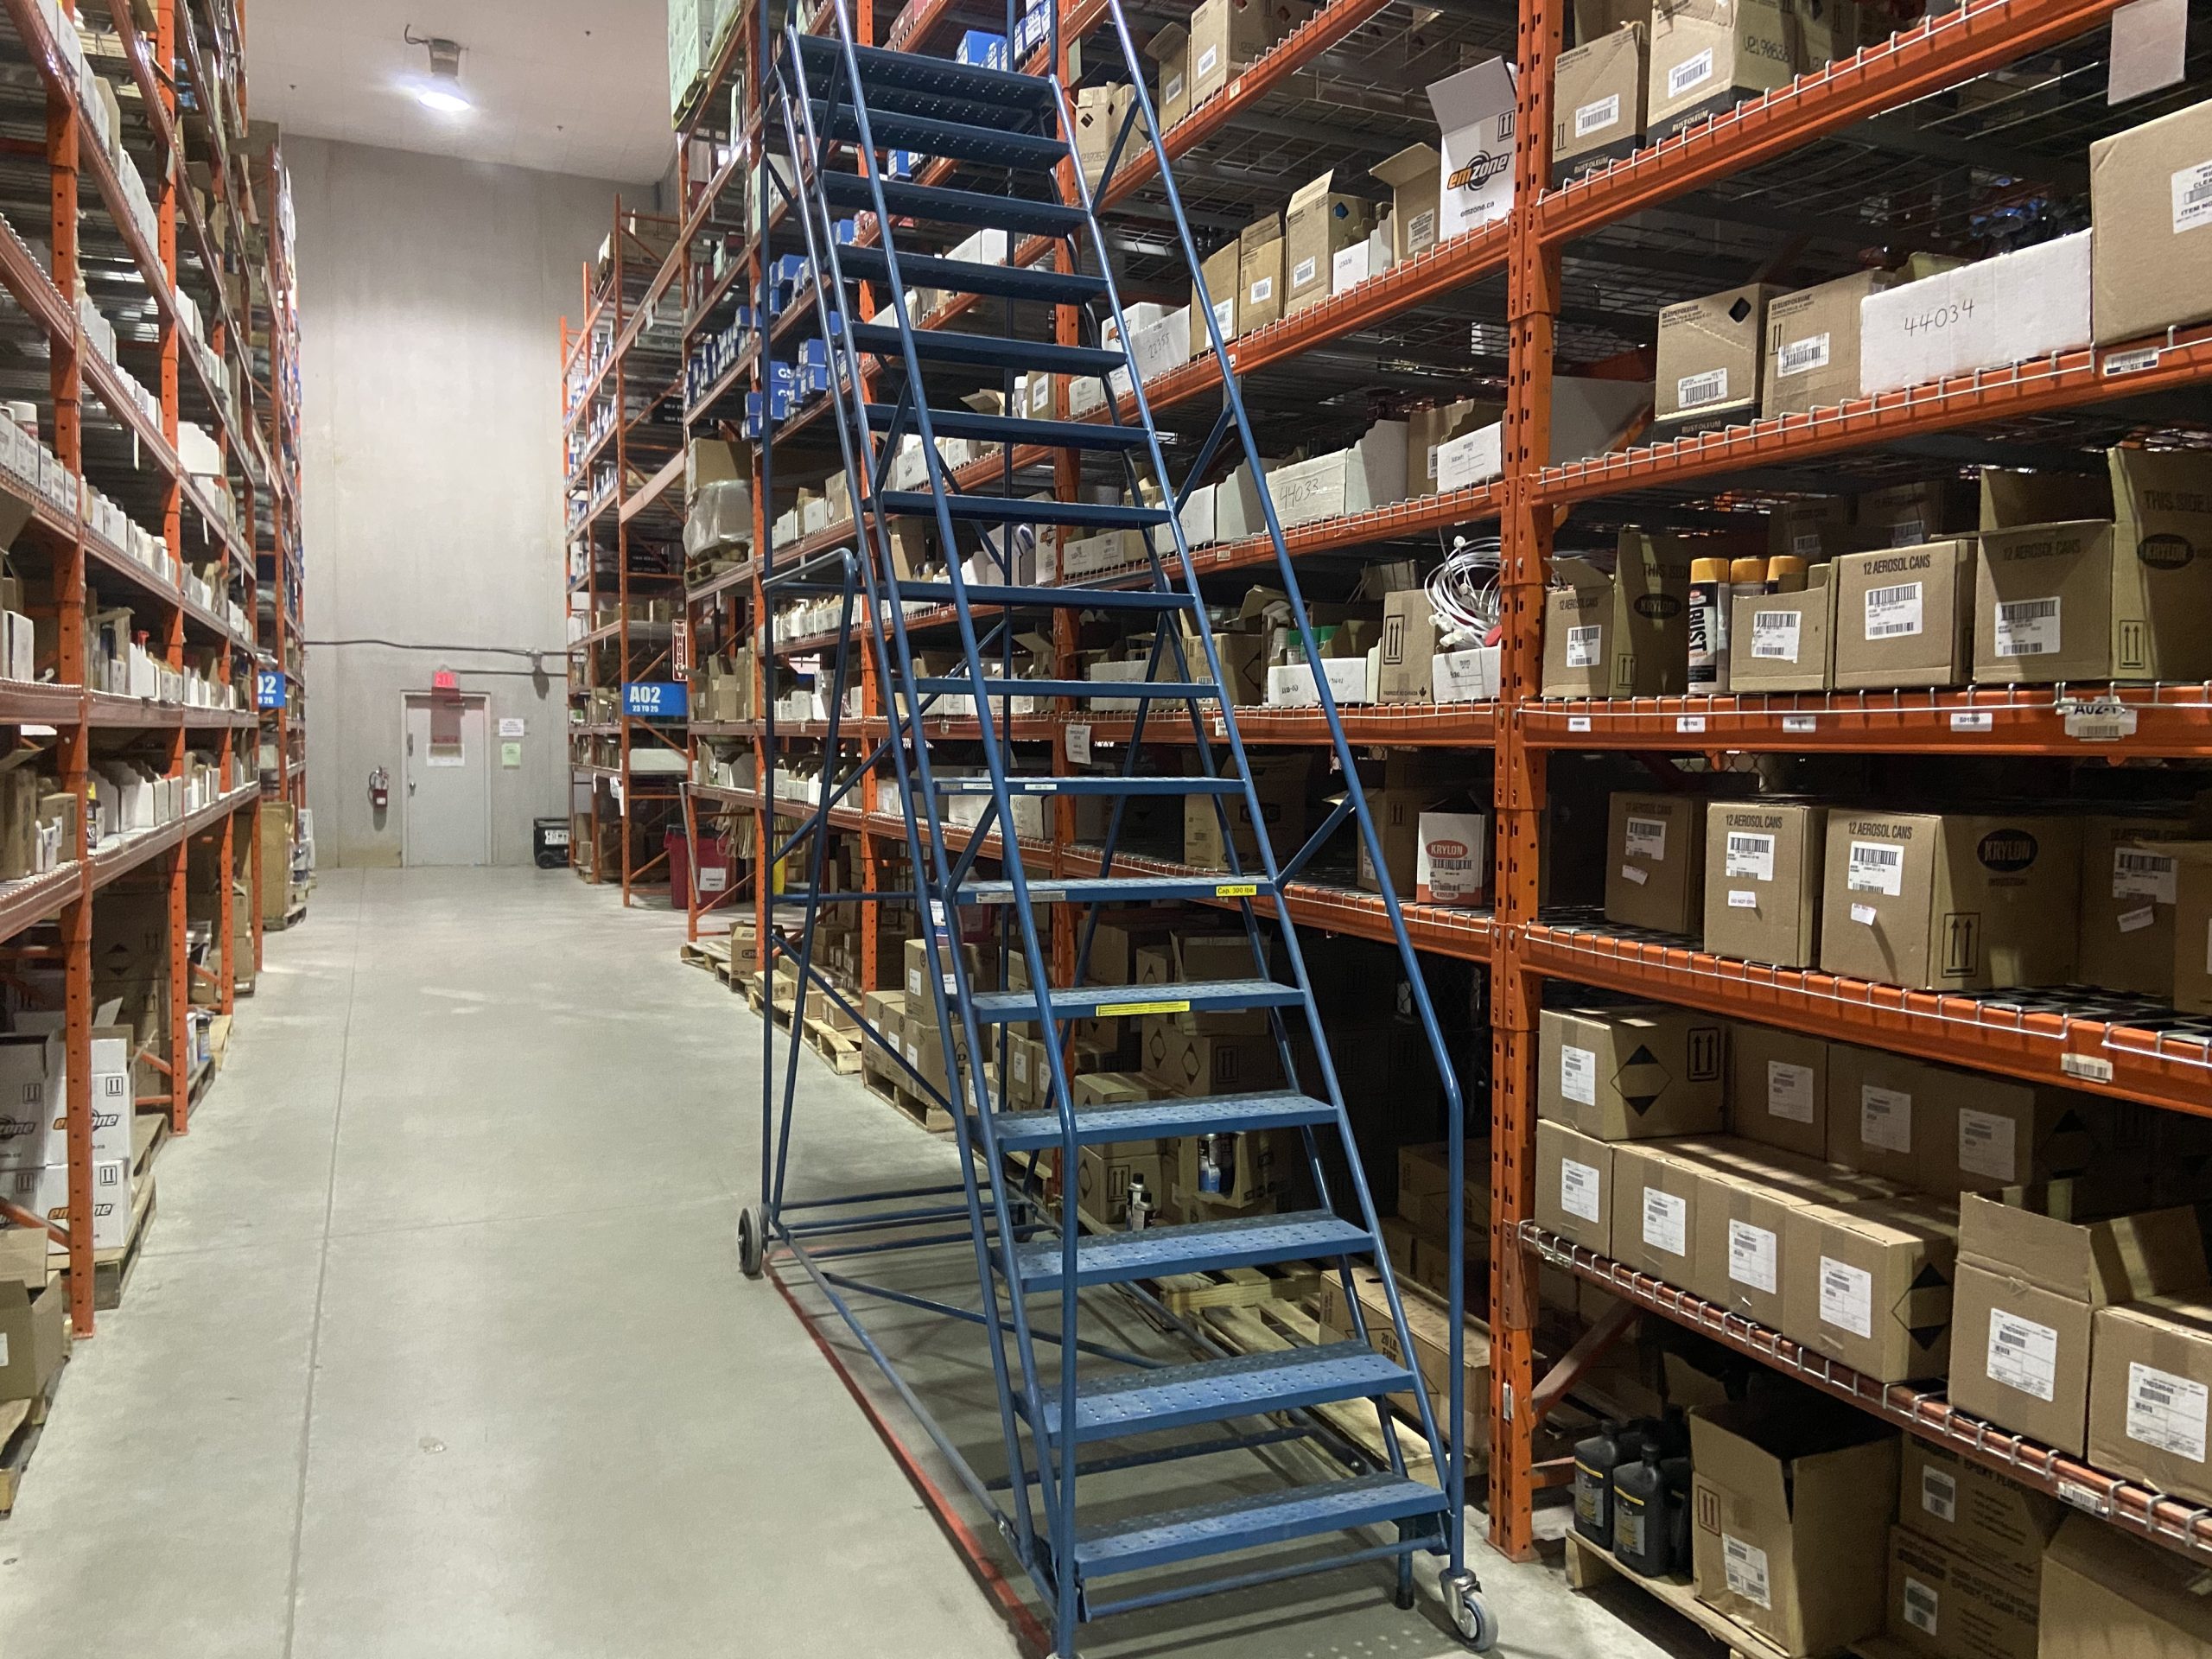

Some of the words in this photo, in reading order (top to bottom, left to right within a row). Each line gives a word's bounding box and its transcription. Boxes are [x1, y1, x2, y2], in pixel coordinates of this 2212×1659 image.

[1447, 152, 1510, 190] emzone
[1460, 200, 1495, 218] emzone.ca
[1904, 298, 1975, 337] 44034
[1280, 479, 1319, 511] 44033
[2014, 542, 2055, 560] AEROSOL
[2056, 539, 2081, 556] CANS
[1863, 562, 1872, 575] 12
[1872, 557, 1908, 575] AEROSOL
[1910, 554, 1931, 570] CANS
[629, 685, 661, 703] A02
[1726, 815, 1733, 826] 12
[1734, 815, 1764, 828] AEROSOL
[1764, 817, 1783, 830] CANS
[1848, 823, 1857, 835] 12
[1858, 823, 1891, 838] AEROSOL
[1892, 825, 1912, 840] CANS
[1431, 844, 1463, 855] KRYLON
[1985, 840, 2031, 861] KRYLON
